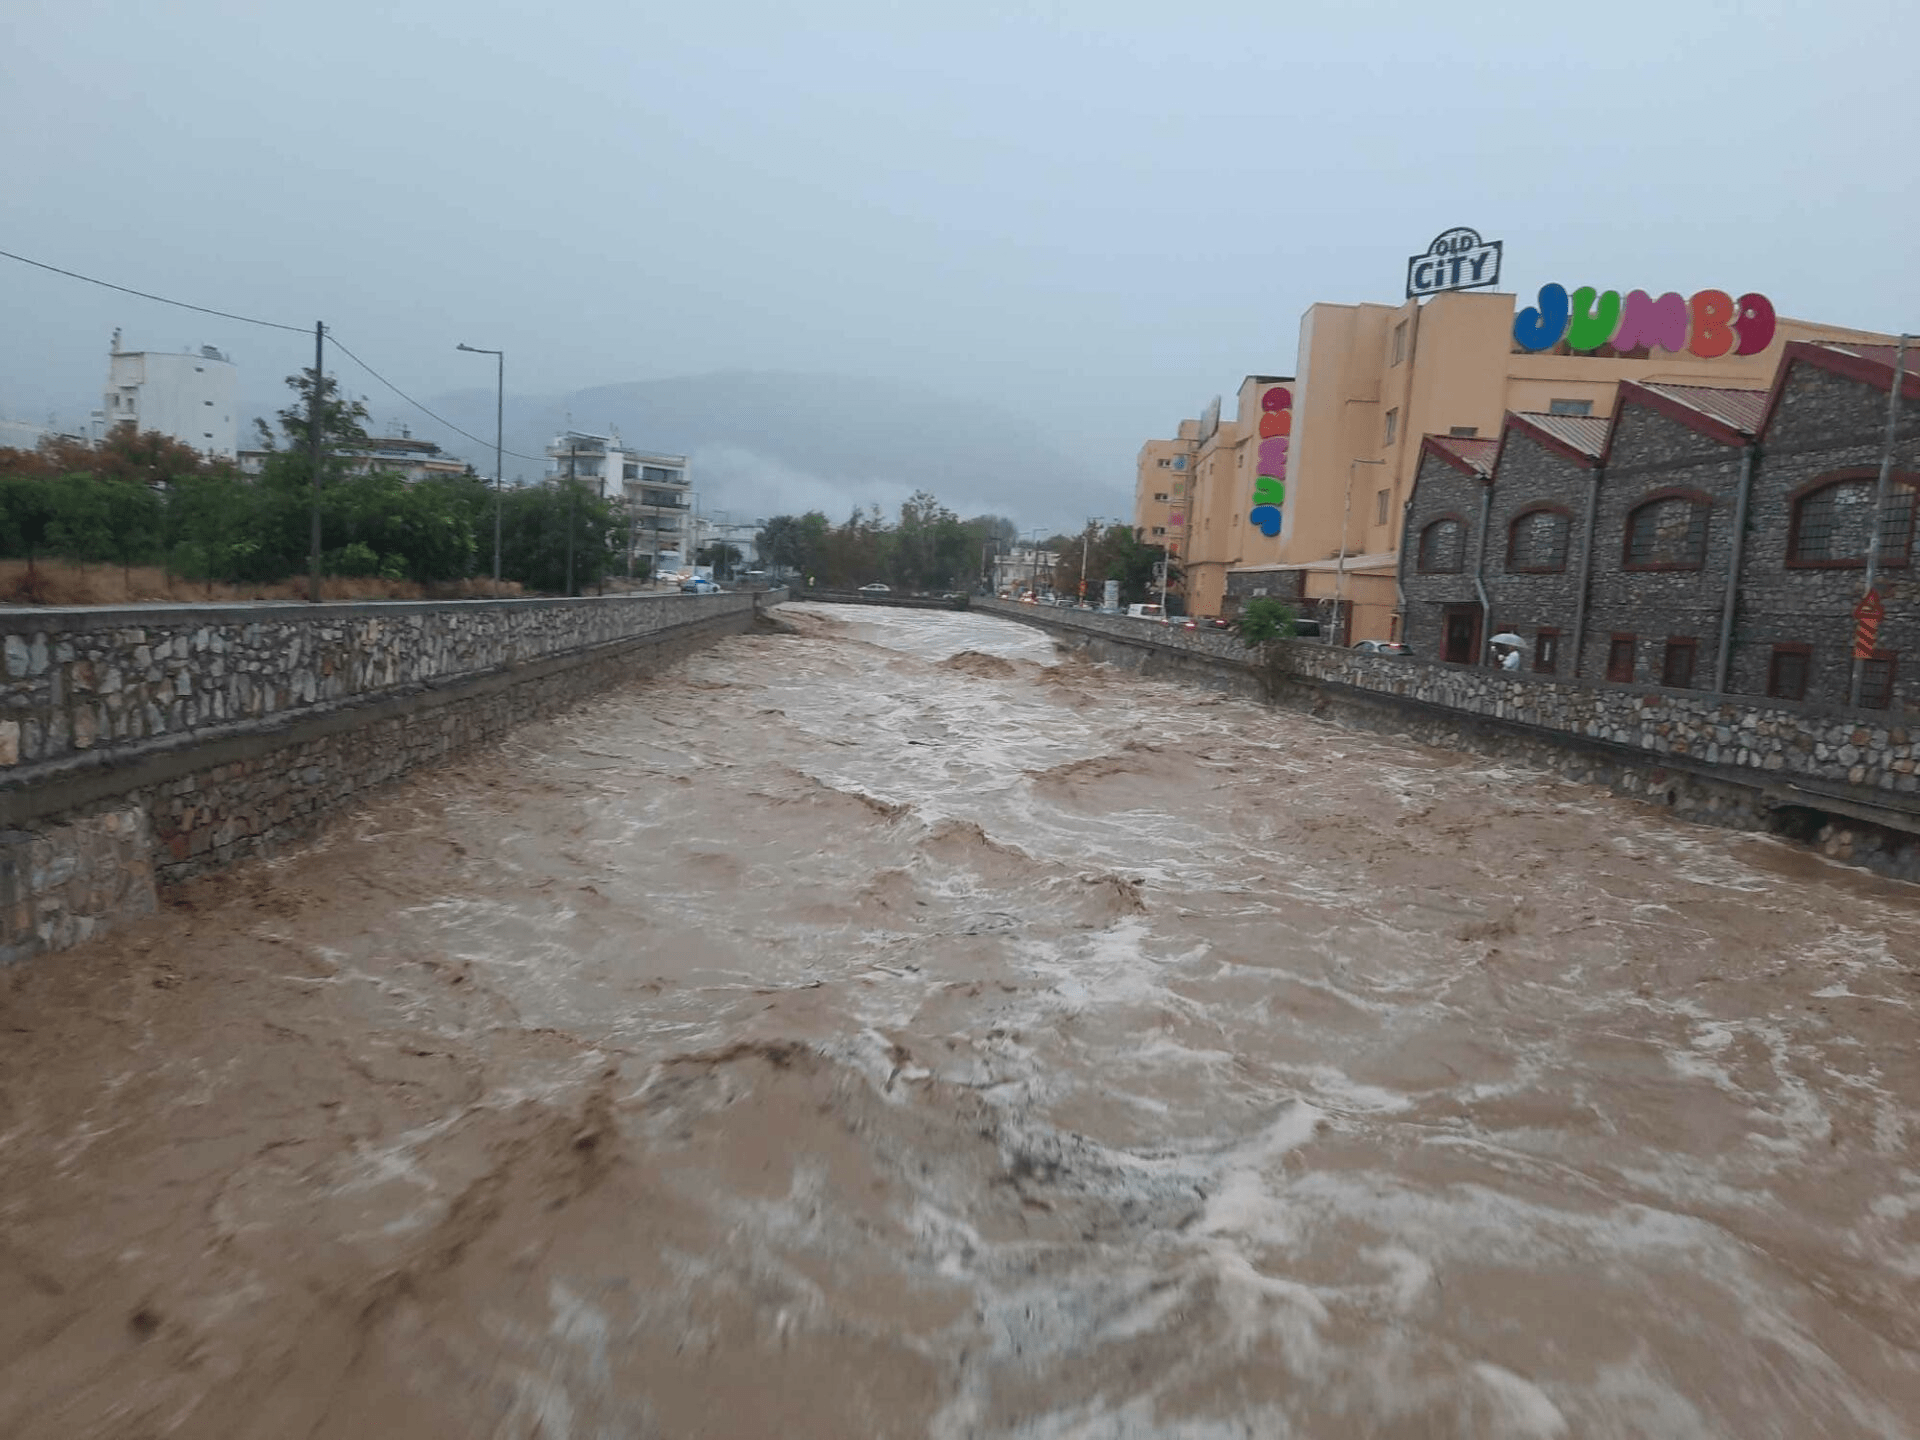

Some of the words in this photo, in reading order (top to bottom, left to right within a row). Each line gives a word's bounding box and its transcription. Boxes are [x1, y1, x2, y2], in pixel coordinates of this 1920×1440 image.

[1435, 236, 1473, 256] OLD
[1513, 282, 1776, 359] JUMBO
[1250, 387, 1293, 537] JUMBO
